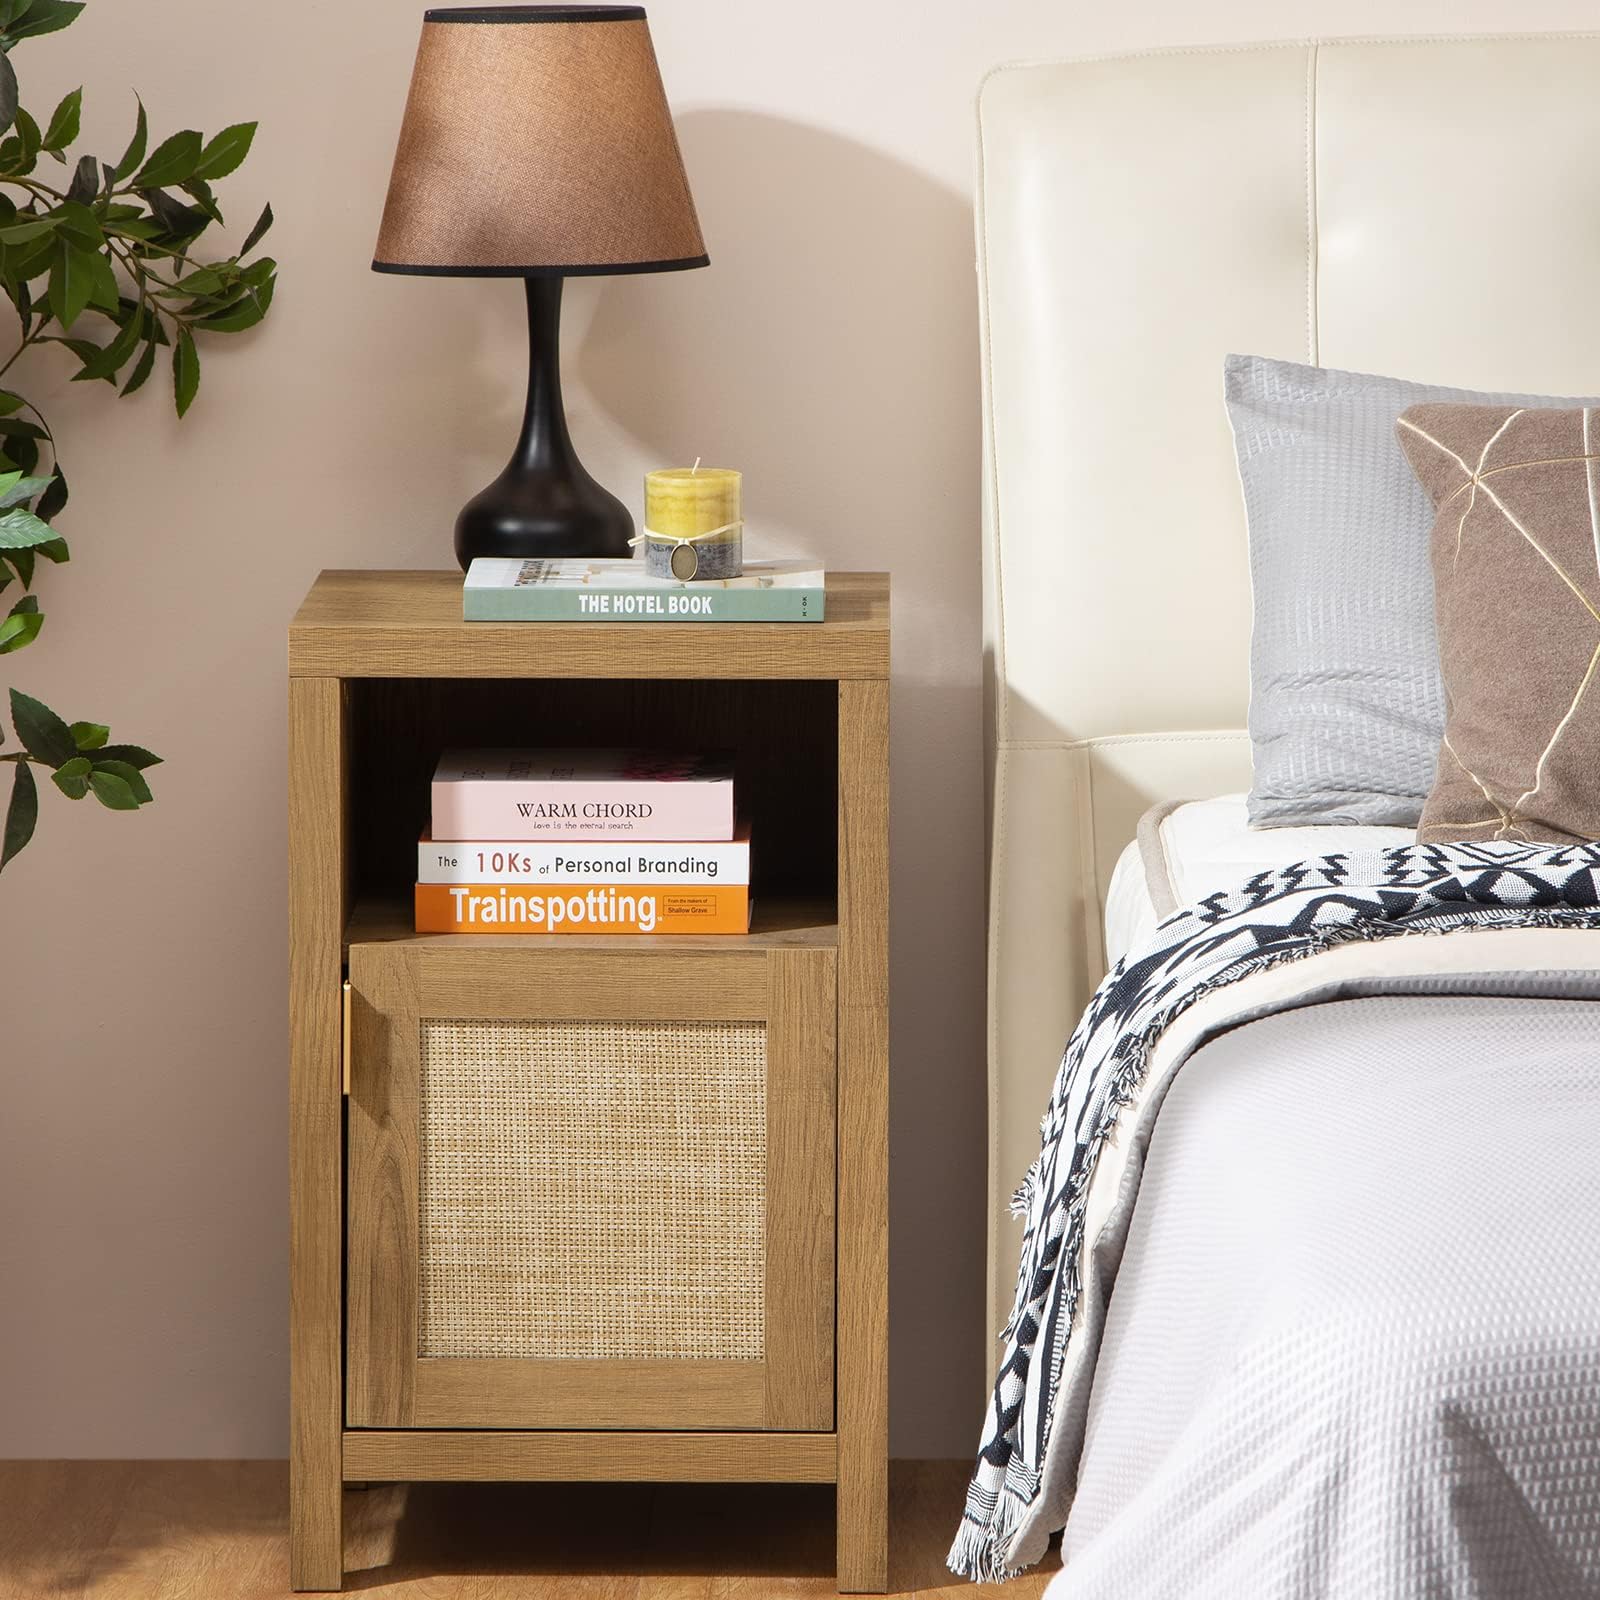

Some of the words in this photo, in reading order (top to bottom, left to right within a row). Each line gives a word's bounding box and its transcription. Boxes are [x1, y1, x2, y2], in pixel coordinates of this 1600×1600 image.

[579, 595, 609, 613] THE
[614, 595, 665, 613] HOTEL
[668, 596, 712, 614] BOOK
[516, 803, 578, 818] WARM
[583, 803, 653, 818] CHORD
[553, 821, 561, 830] is
[565, 821, 577, 830] the
[580, 821, 605, 830] eternal
[608, 821, 633, 830] search
[438, 856, 458, 867] The
[477, 852, 532, 873] 10Ks
[539, 865, 550, 874] of
[555, 857, 631, 873] Personal
[638, 857, 718, 877] Branding
[449, 887, 656, 932] Trainspotting
[691, 906, 708, 914] Grave
